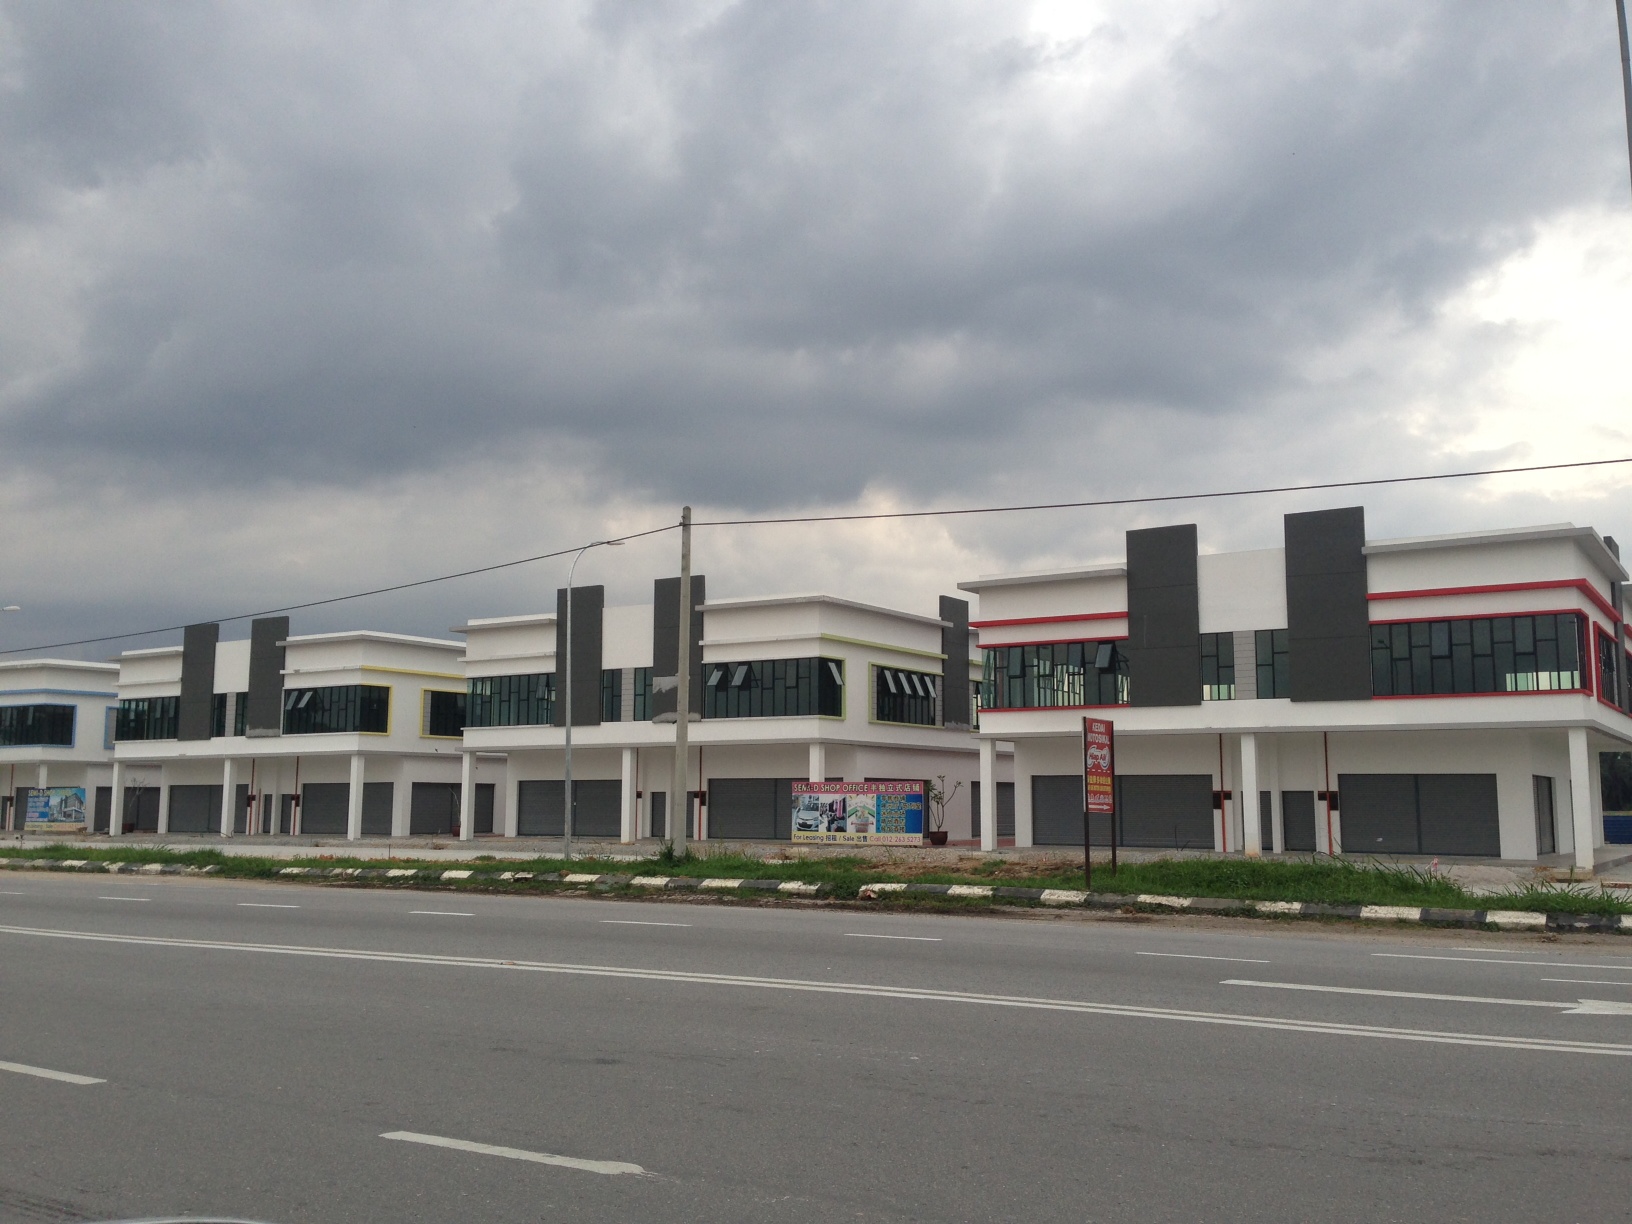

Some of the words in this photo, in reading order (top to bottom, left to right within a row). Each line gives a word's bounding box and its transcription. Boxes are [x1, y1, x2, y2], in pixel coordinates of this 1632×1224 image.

[821, 784, 841, 792] SHOP
[842, 784, 868, 792] OFFICE
[803, 834, 824, 842] Leasing
[869, 835, 881, 843] Call
